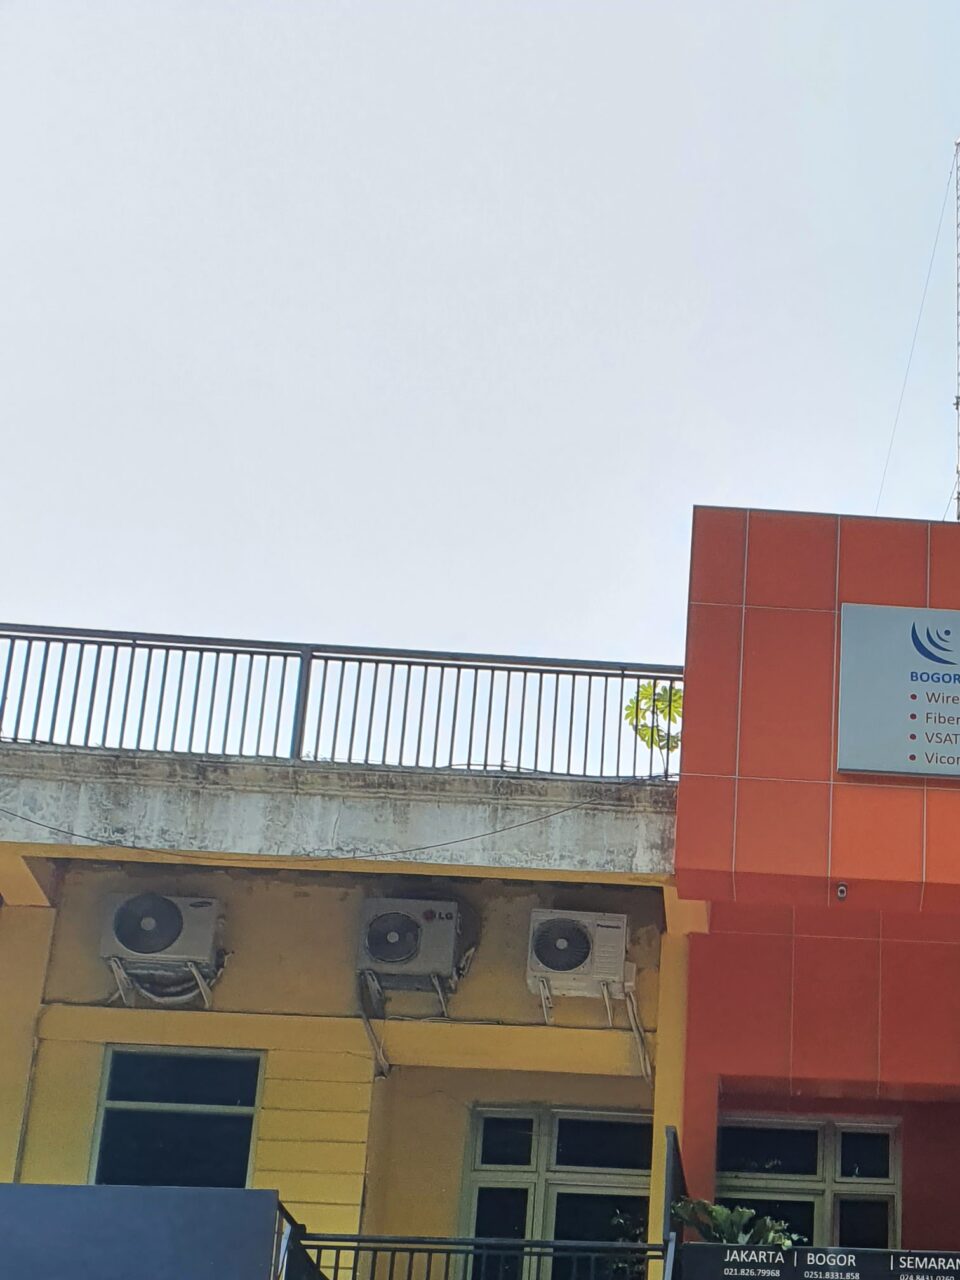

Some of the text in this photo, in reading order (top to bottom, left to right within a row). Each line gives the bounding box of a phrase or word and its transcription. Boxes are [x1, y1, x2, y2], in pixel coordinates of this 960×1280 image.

[925, 732, 960, 745] VSAT
[724, 1250, 785, 1264] JAKARTA
[807, 1253, 856, 1267] BOGOR
[724, 1268, 780, 1277] 021.826.79968
